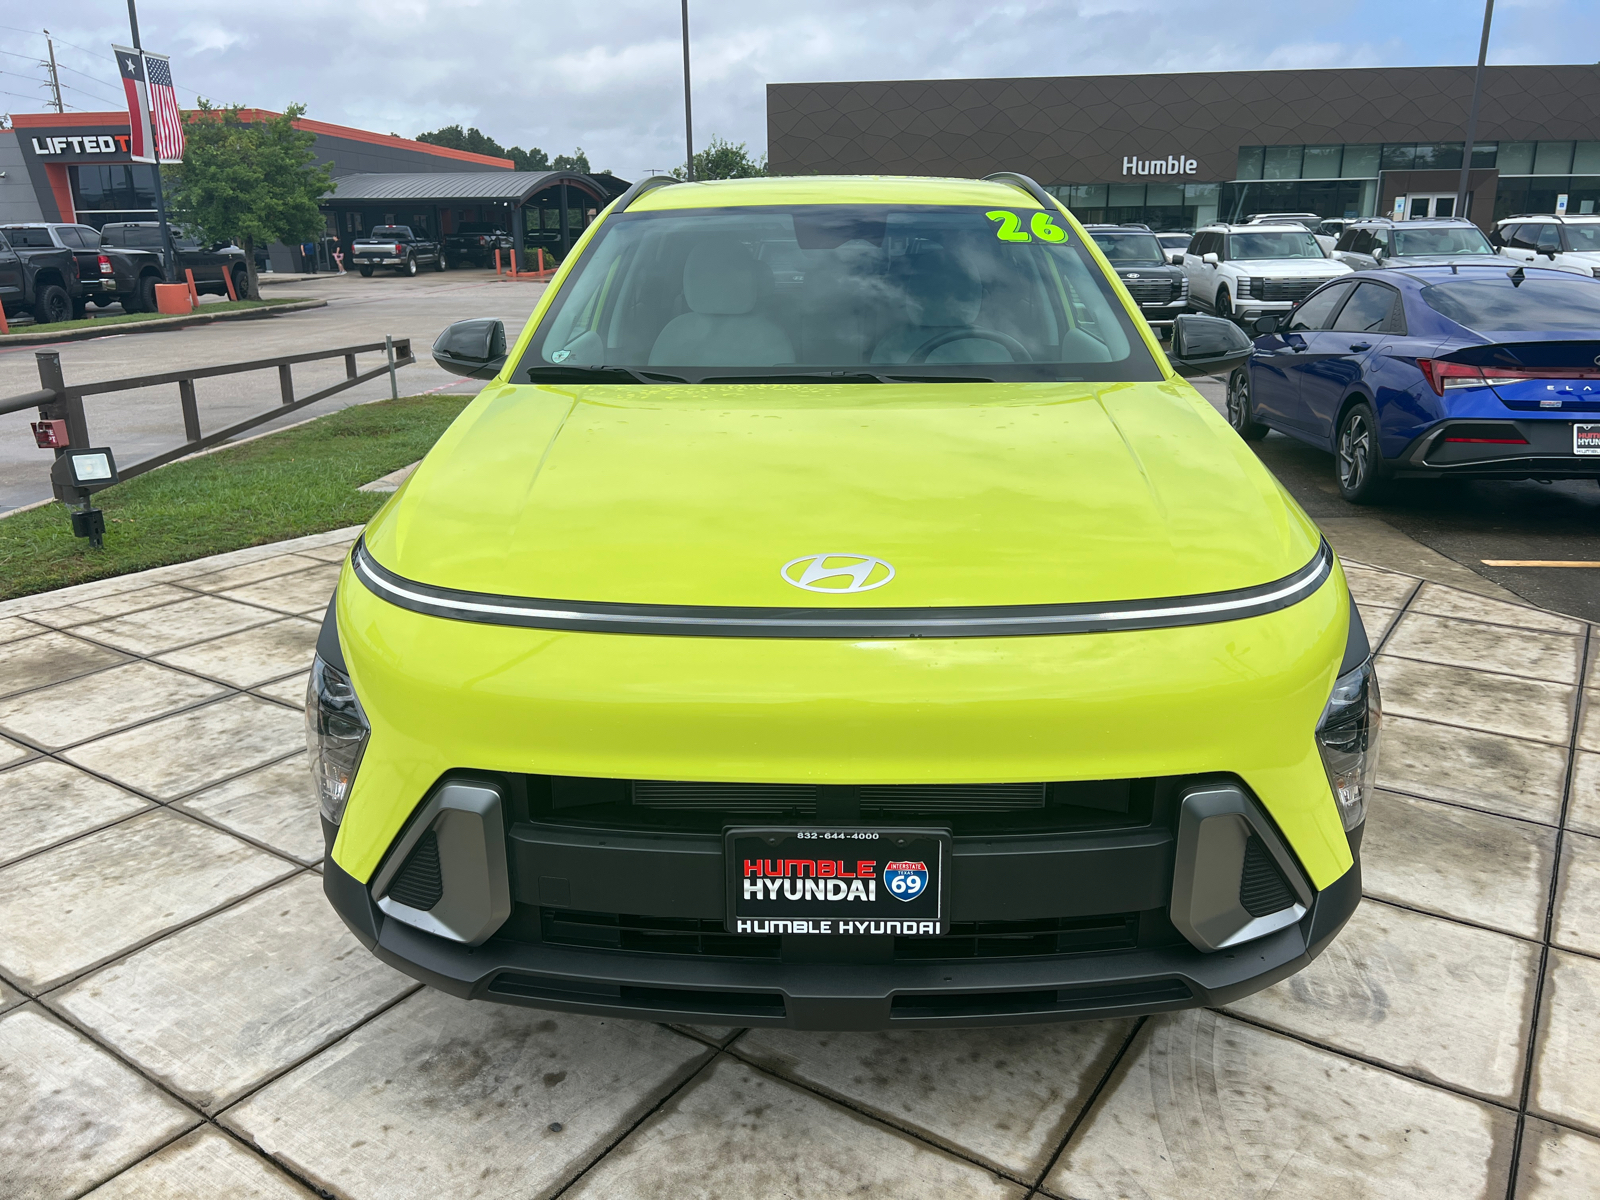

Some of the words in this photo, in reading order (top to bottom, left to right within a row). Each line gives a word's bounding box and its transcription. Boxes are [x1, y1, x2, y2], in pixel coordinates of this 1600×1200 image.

[1122, 155, 1198, 176] Humble
[985, 210, 1069, 243] 26
[797, 832, 879, 840] 832-644-4000
[743, 859, 877, 878] HUMBLE
[743, 879, 876, 902] HYUNDAI
[891, 875, 921, 894] 69
[737, 920, 832, 934] HUMBLE
[839, 920, 941, 935] HYUNDAI
